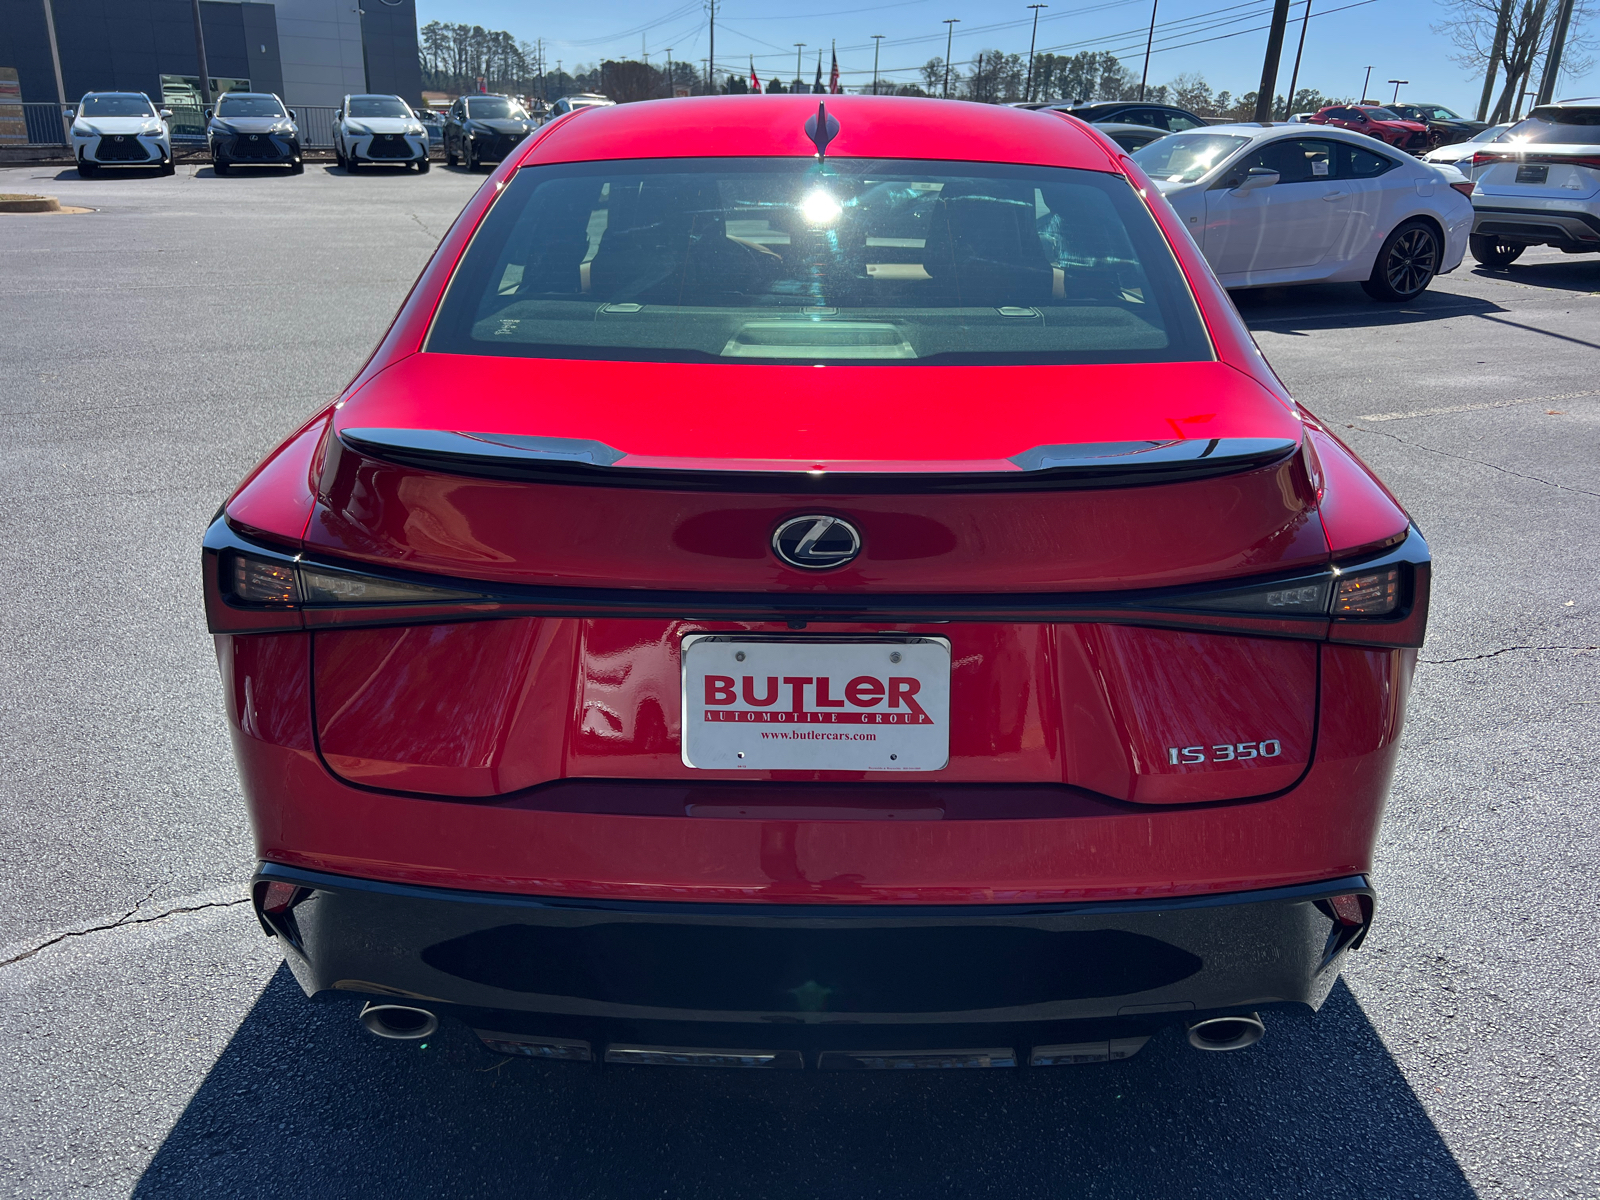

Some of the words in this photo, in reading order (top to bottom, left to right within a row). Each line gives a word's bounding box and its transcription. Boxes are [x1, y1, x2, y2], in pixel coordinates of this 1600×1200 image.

[706, 712, 838, 722] AUTOMOTIVE
[861, 713, 926, 723] GROUP
[761, 730, 877, 741] www.butlercars.com
[1168, 745, 1206, 766] IS
[1212, 739, 1282, 762] 350
